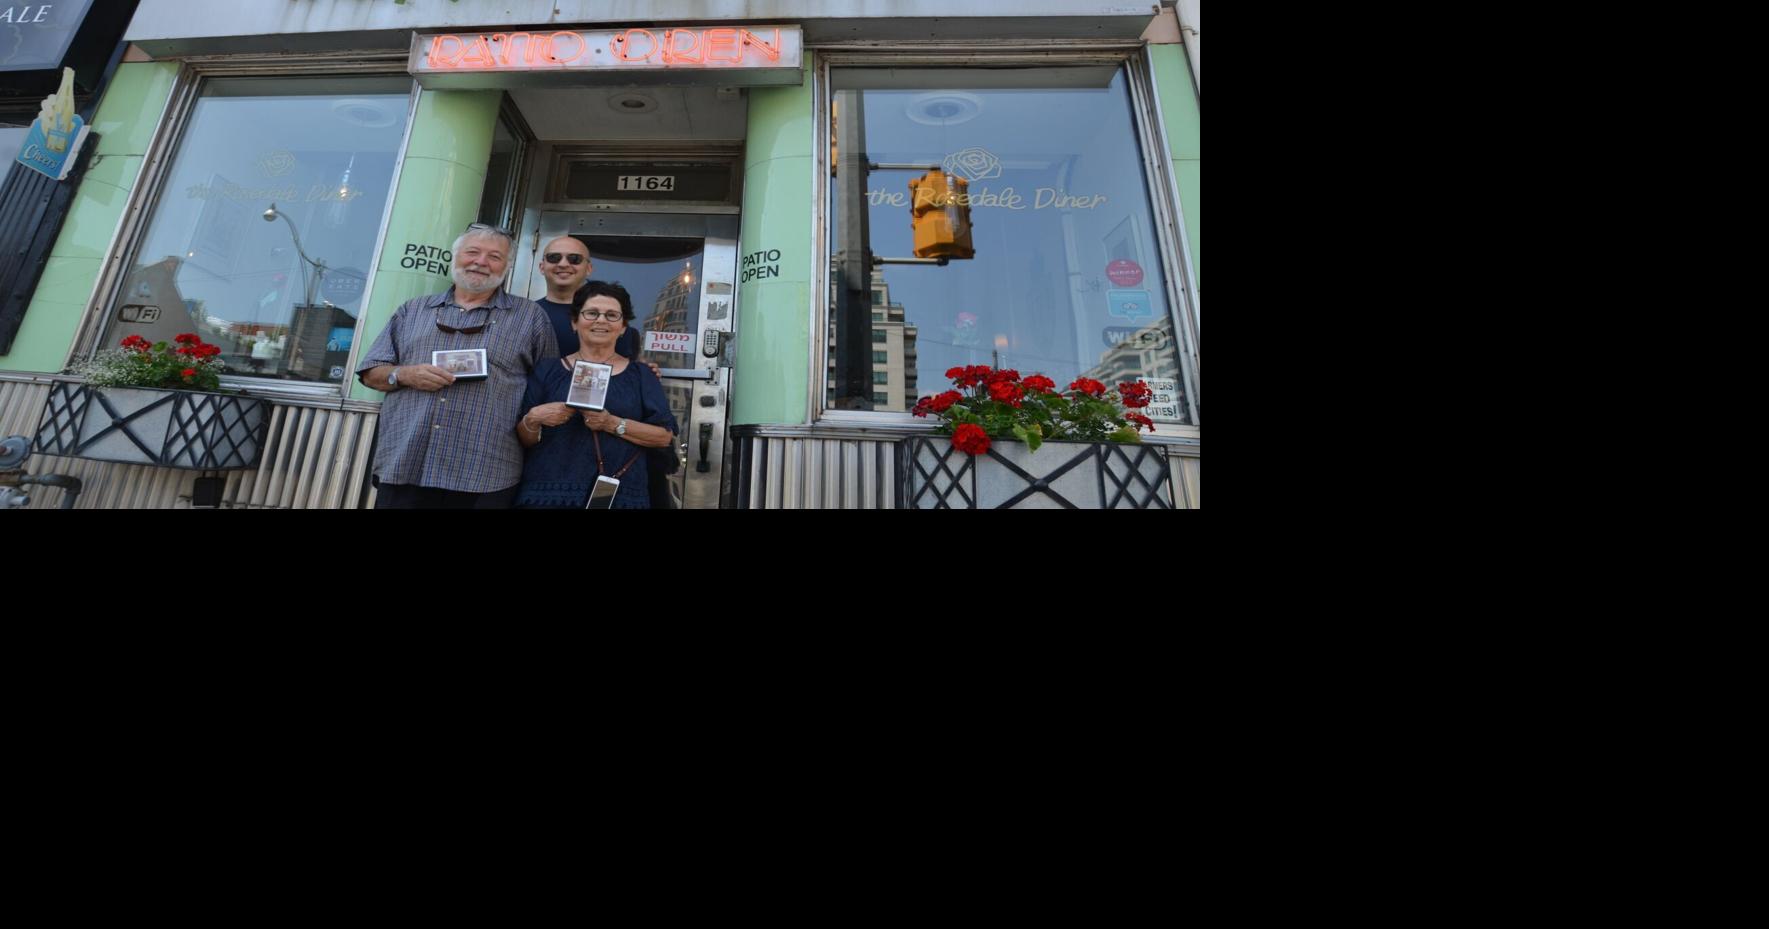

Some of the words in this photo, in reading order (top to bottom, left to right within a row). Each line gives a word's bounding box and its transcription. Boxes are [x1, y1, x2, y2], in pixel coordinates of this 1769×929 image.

[428, 31, 584, 67] PATIO
[610, 28, 781, 65] OPEN
[620, 176, 673, 190] 1164
[865, 188, 908, 206] the
[1034, 187, 1106, 209] Diner
[405, 243, 453, 262] PATIO
[742, 249, 781, 269] PATIO
[400, 256, 449, 277] OPEN
[741, 264, 779, 283] OPEN
[651, 342, 688, 352] PULL
